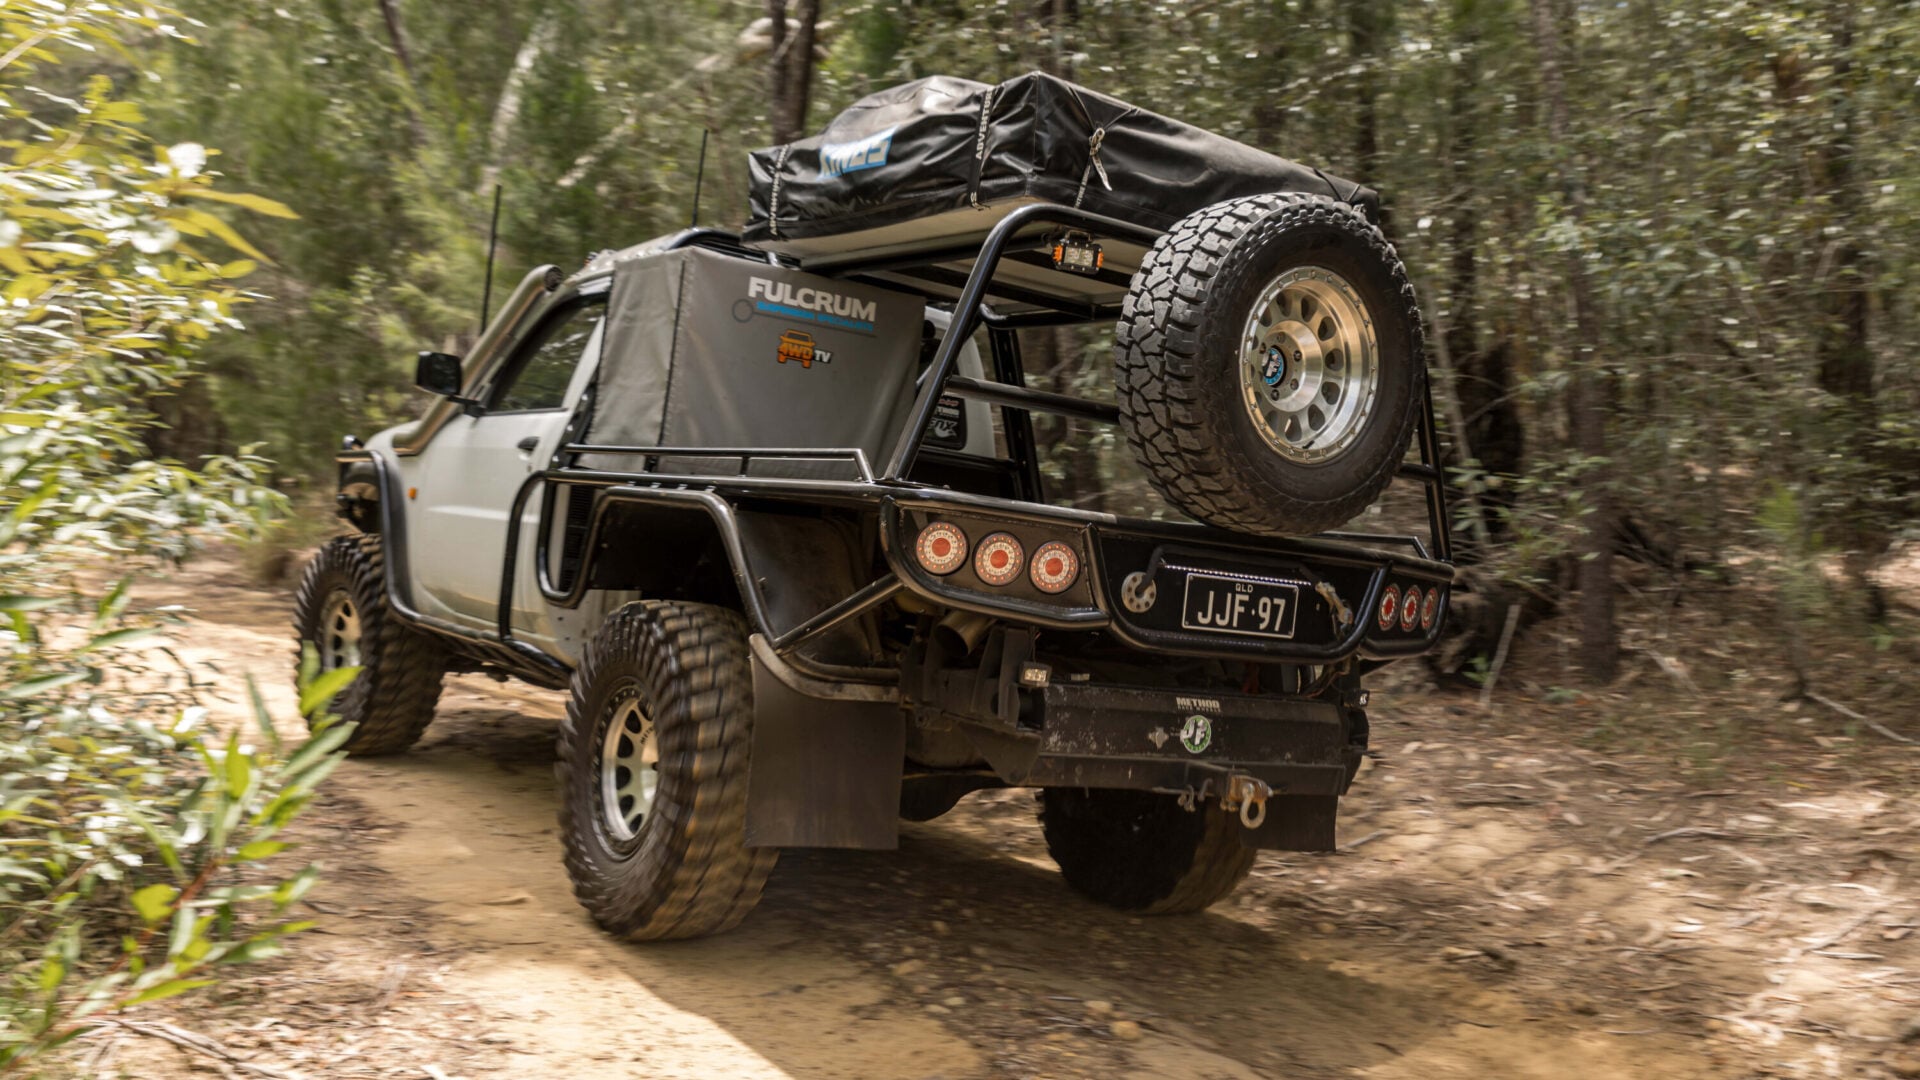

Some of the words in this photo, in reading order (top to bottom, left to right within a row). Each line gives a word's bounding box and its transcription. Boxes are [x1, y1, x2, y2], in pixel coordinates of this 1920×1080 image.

[748, 276, 877, 321] FULCRUM
[814, 349, 832, 363] TV
[1235, 583, 1254, 593] QLD
[1176, 696, 1220, 709] METHOD
